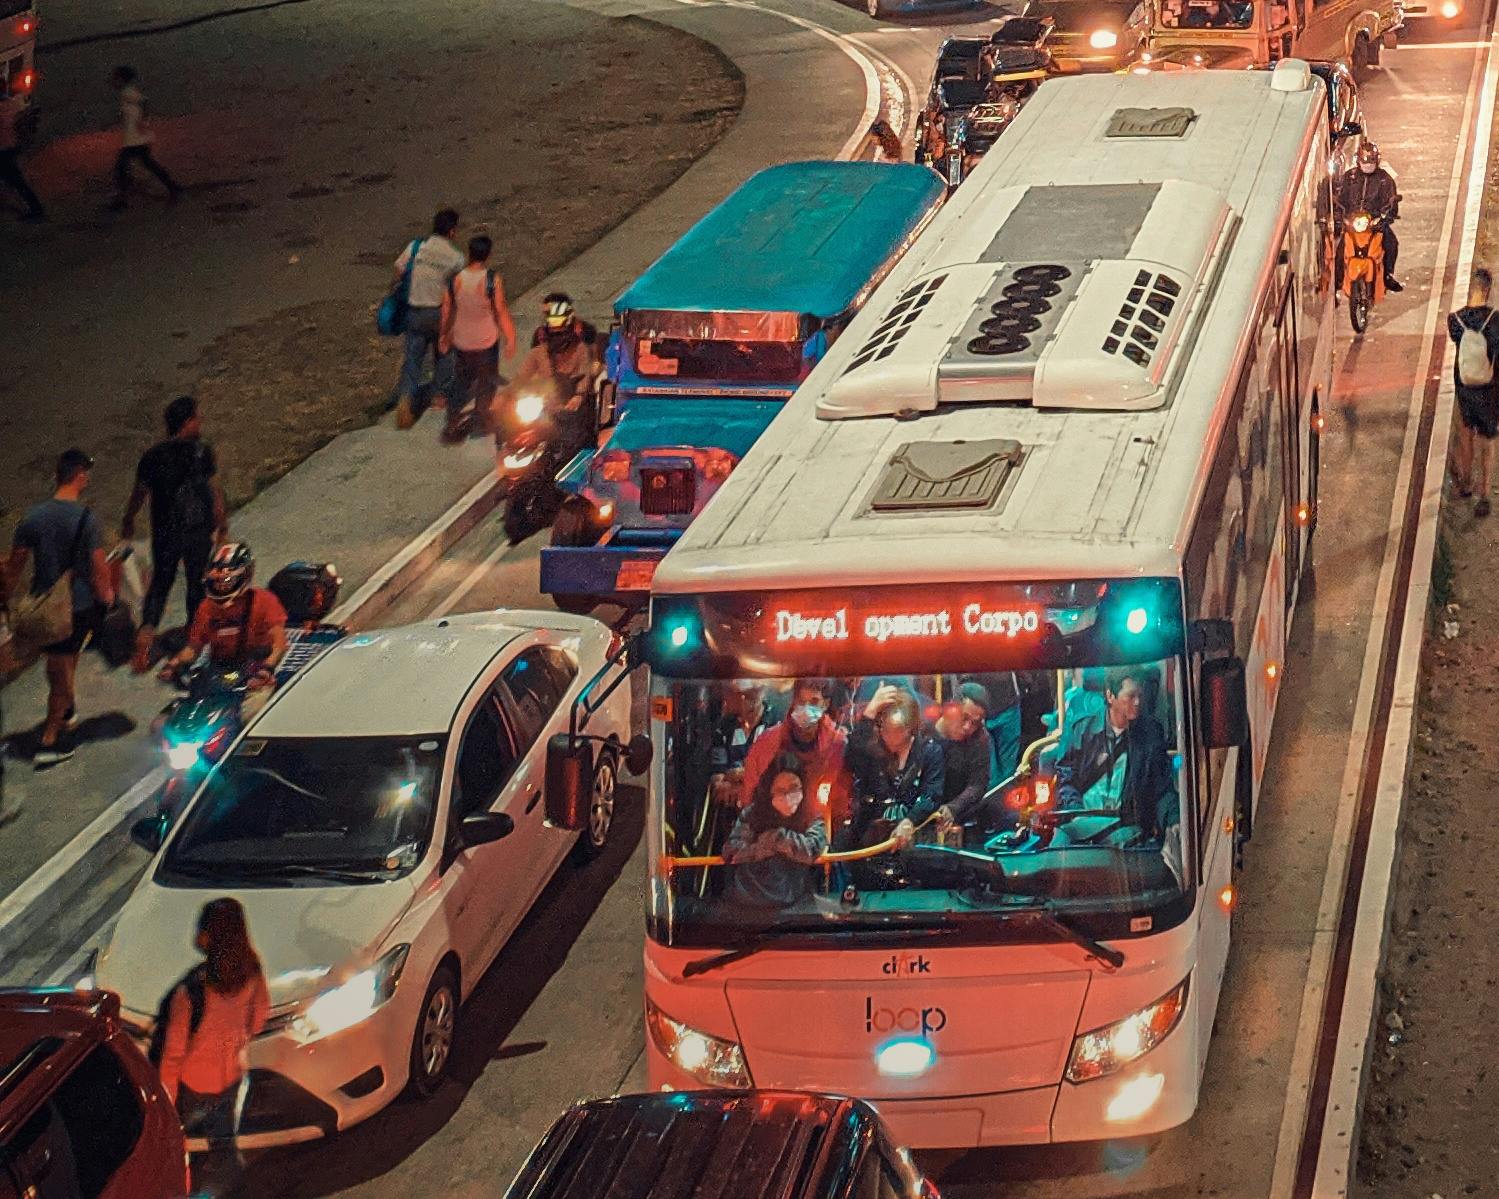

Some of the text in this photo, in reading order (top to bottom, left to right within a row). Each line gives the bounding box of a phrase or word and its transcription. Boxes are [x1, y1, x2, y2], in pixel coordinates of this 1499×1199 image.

[776, 603, 1038, 642] Devel opment Corpo
[866, 997, 947, 1040] loop
